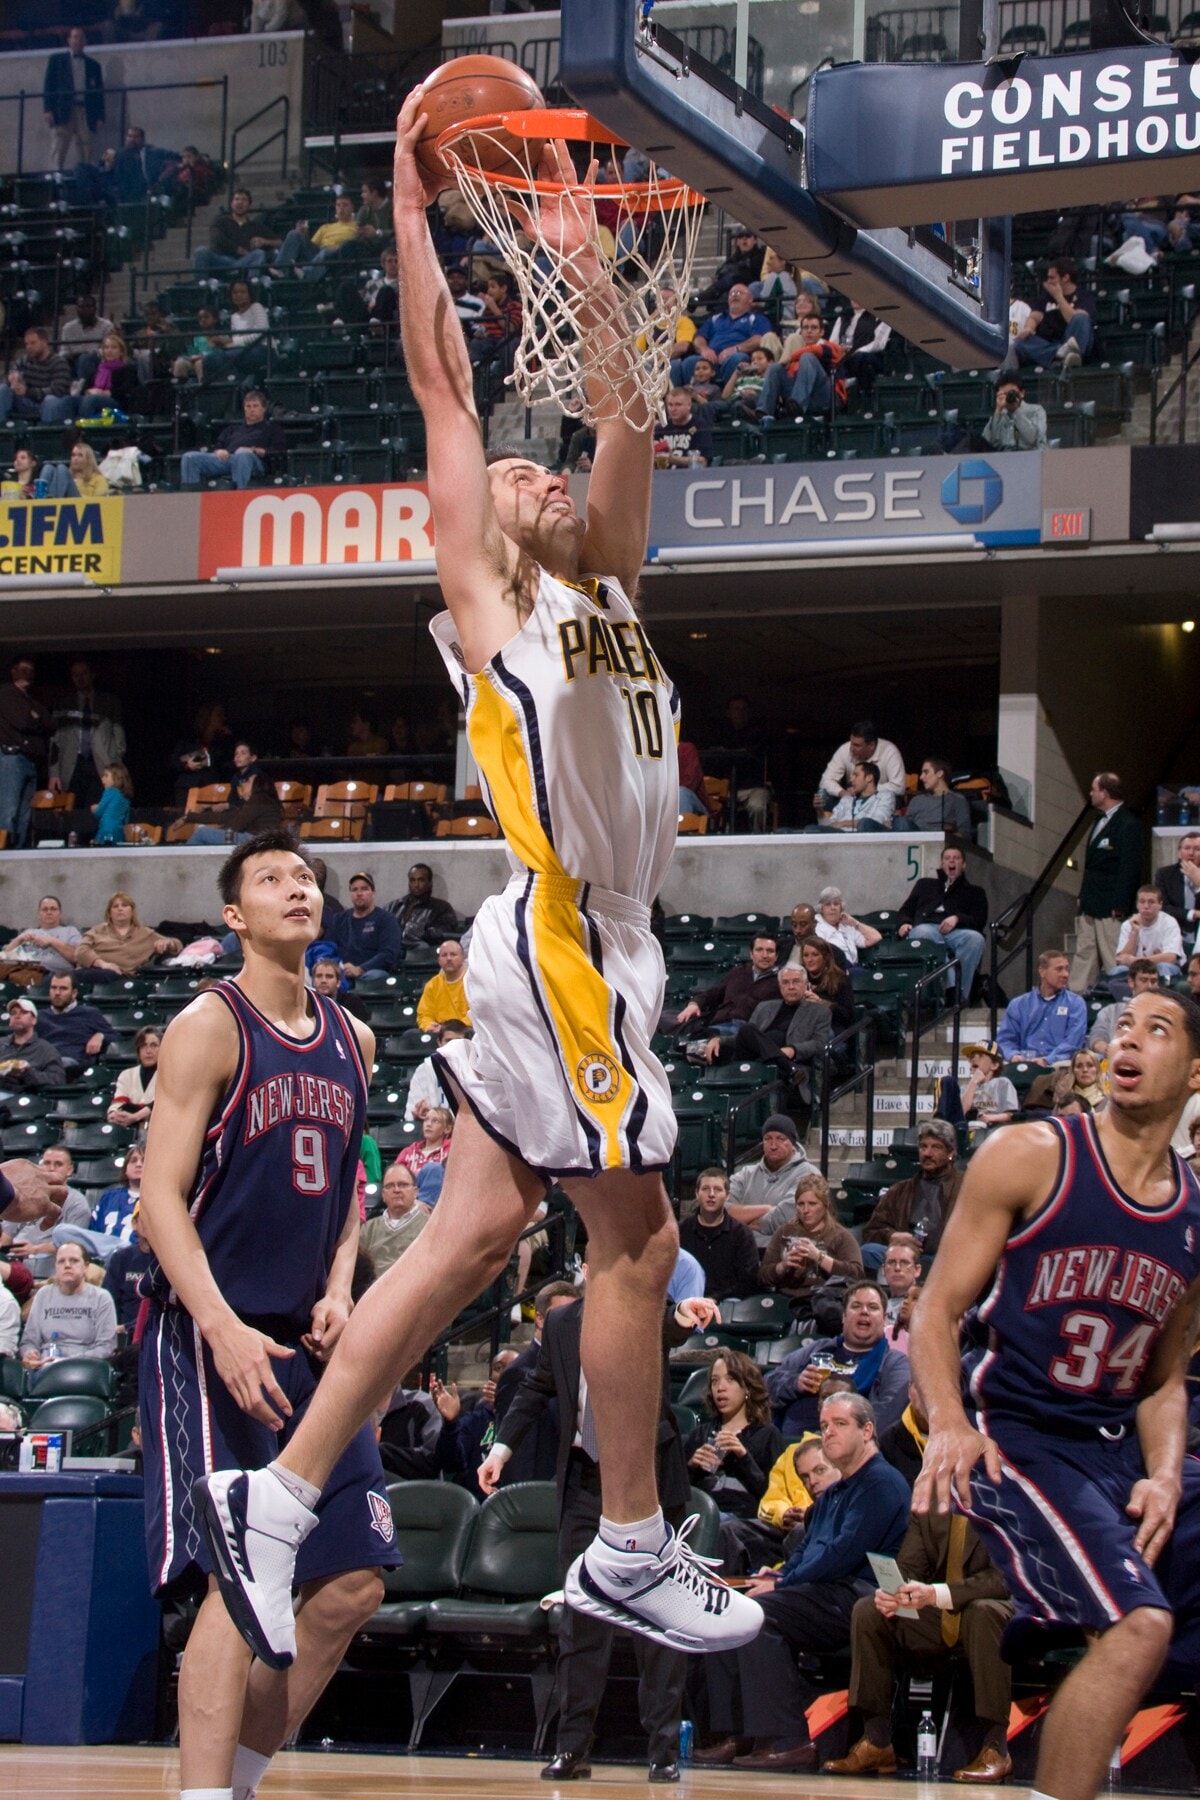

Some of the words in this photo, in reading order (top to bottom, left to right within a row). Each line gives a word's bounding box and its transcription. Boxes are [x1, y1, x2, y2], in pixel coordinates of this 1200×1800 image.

[258, 40, 288, 68] 103
[944, 57, 1200, 128] CONSE
[684, 470, 925, 529] CHASE
[1052, 512, 1084, 537] EXIT
[0, 553, 102, 575] CENTER
[621, 687, 664, 761] 10
[907, 845, 919, 881] 5
[924, 1063, 944, 1075] You
[947, 1065, 966, 1075] cn
[245, 1073, 293, 1144] NEW
[876, 1099, 902, 1110] Have
[904, 1101, 924, 1112] yu
[828, 1133, 846, 1145] We
[876, 1132, 889, 1145] all
[292, 1126, 329, 1195] 9
[1027, 1246, 1119, 1308] NEW
[44, 1307, 92, 1320] YELLOWSTONE
[1050, 1311, 1157, 1393] 34
